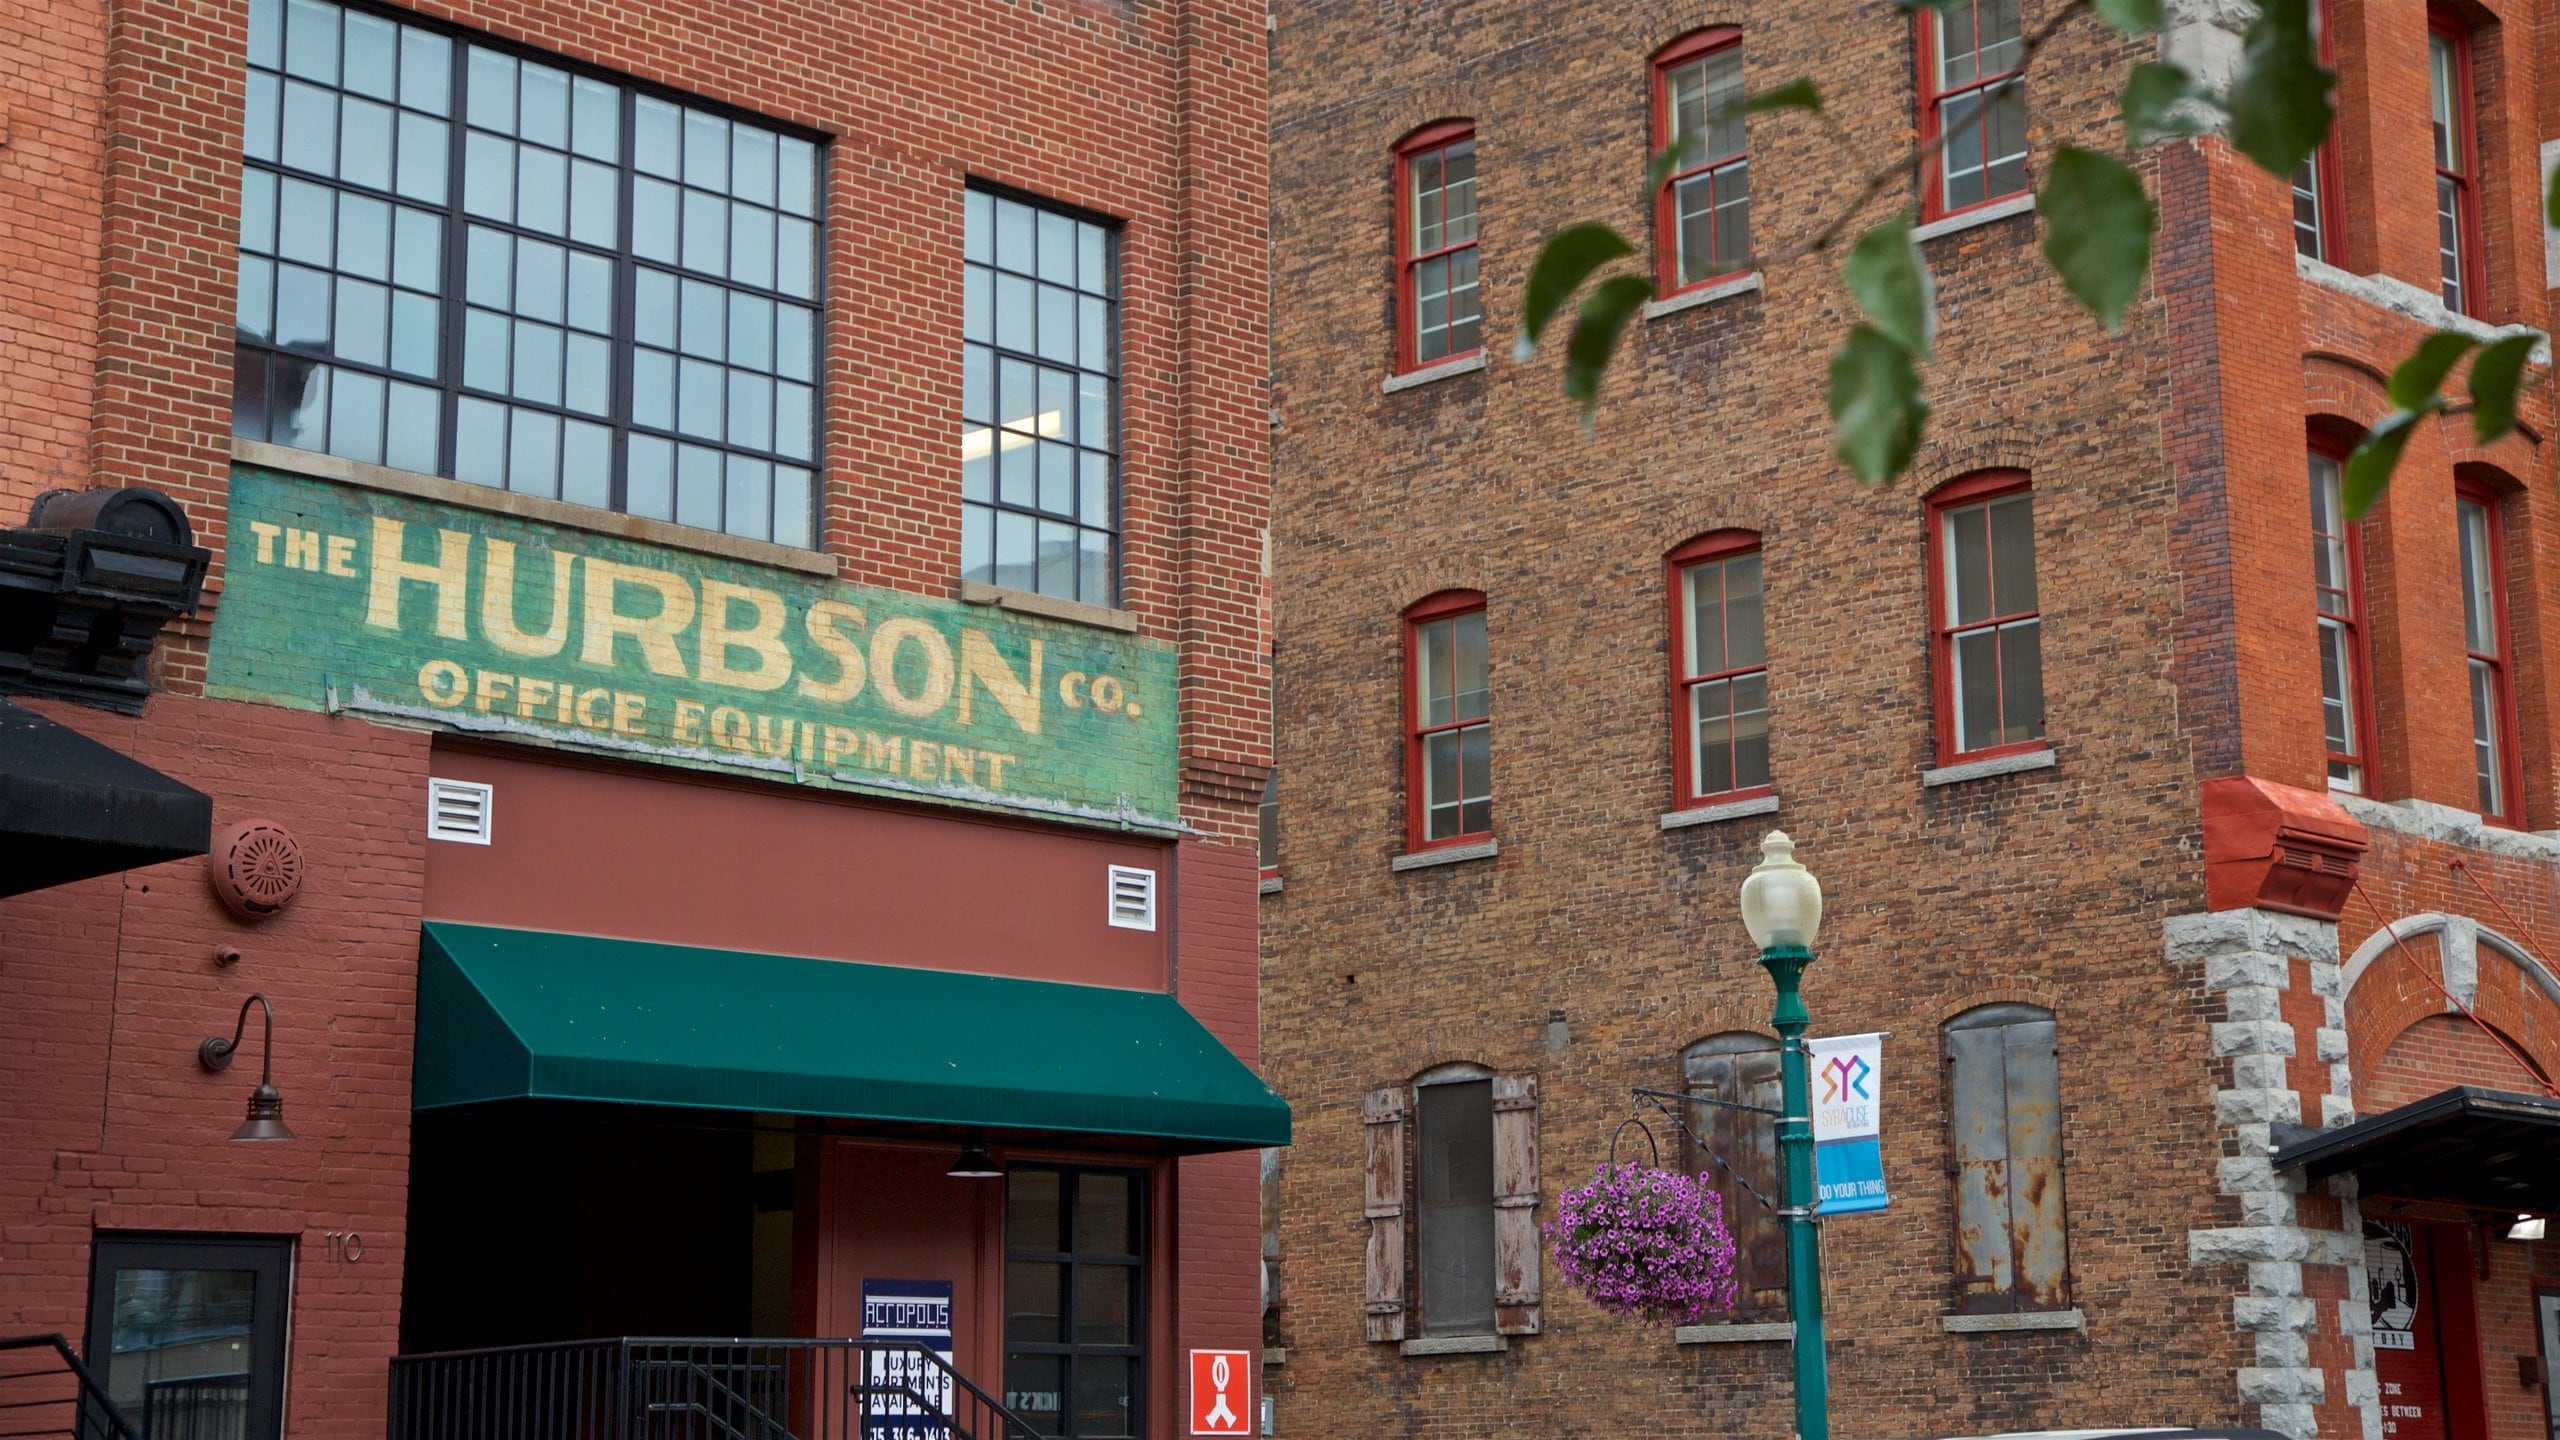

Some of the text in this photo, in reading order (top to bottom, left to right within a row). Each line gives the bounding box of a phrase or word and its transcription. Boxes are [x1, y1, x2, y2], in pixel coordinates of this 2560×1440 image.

[250, 515, 1142, 735] THE HURBSON CO.
[417, 659, 1017, 788] OFFICE EQUIPMENT
[1822, 1105, 1869, 1127] SYRACUSE
[1820, 1179, 1885, 1200] DO YOUR THING
[325, 1231, 363, 1263] 110
